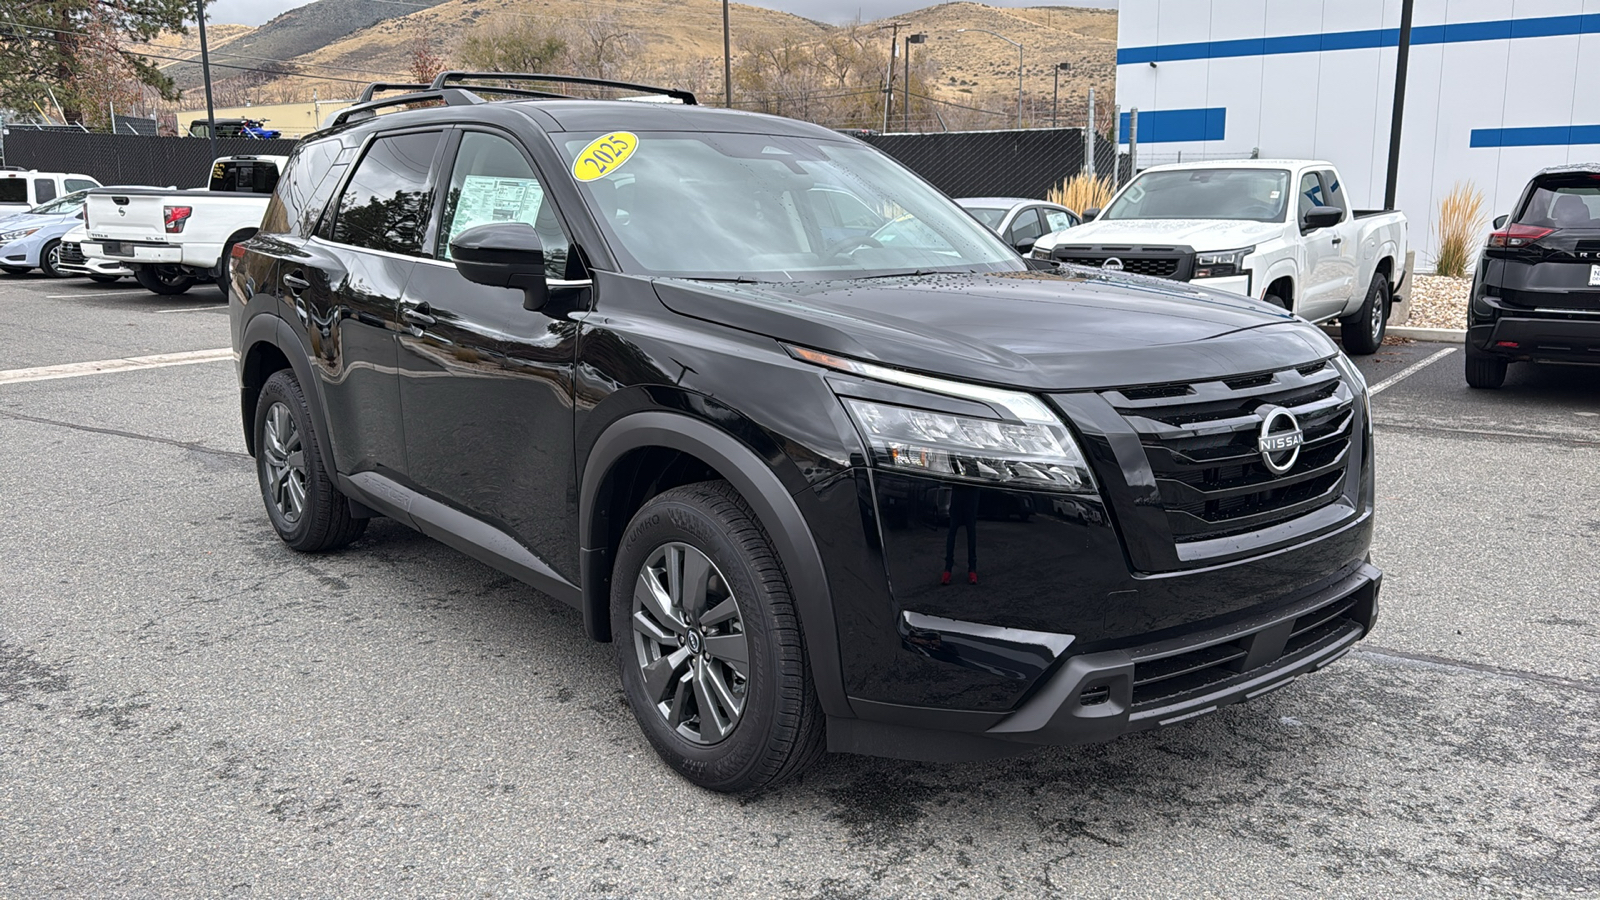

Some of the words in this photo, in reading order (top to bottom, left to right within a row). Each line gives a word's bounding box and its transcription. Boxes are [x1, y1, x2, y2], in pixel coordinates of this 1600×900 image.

[584, 135, 629, 173] 2025
[1260, 434, 1303, 451] NISSAN
[624, 514, 660, 553] KUMHO
